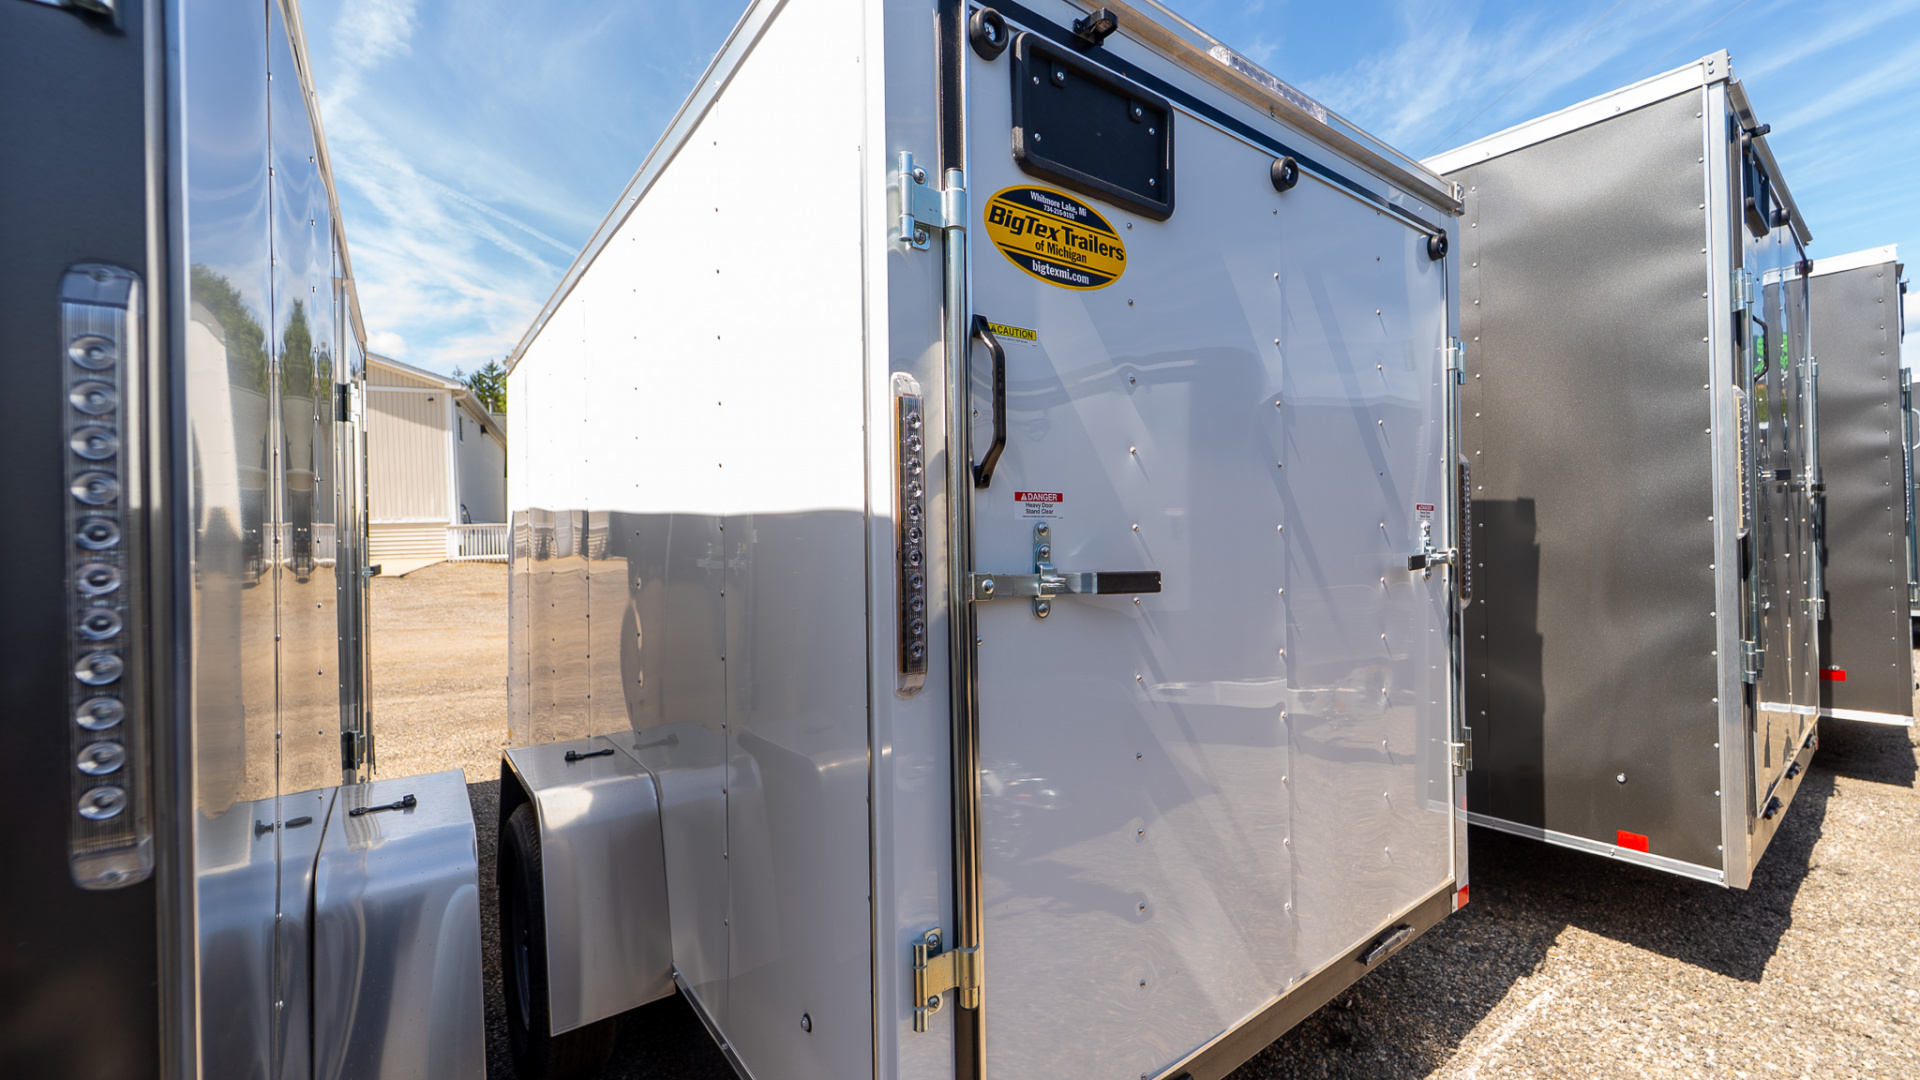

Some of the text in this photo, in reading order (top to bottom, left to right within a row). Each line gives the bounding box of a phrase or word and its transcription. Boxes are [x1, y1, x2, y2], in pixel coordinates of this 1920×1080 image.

[1030, 190, 1087, 217] Whitmore Lake, Mi
[1035, 240, 1087, 264] of Michigan
[1061, 225, 1125, 261] Trailers
[1032, 260, 1090, 284] bigtexmi.com
[997, 325, 1033, 339] CAUTION
[1027, 493, 1057, 501] DANGER
